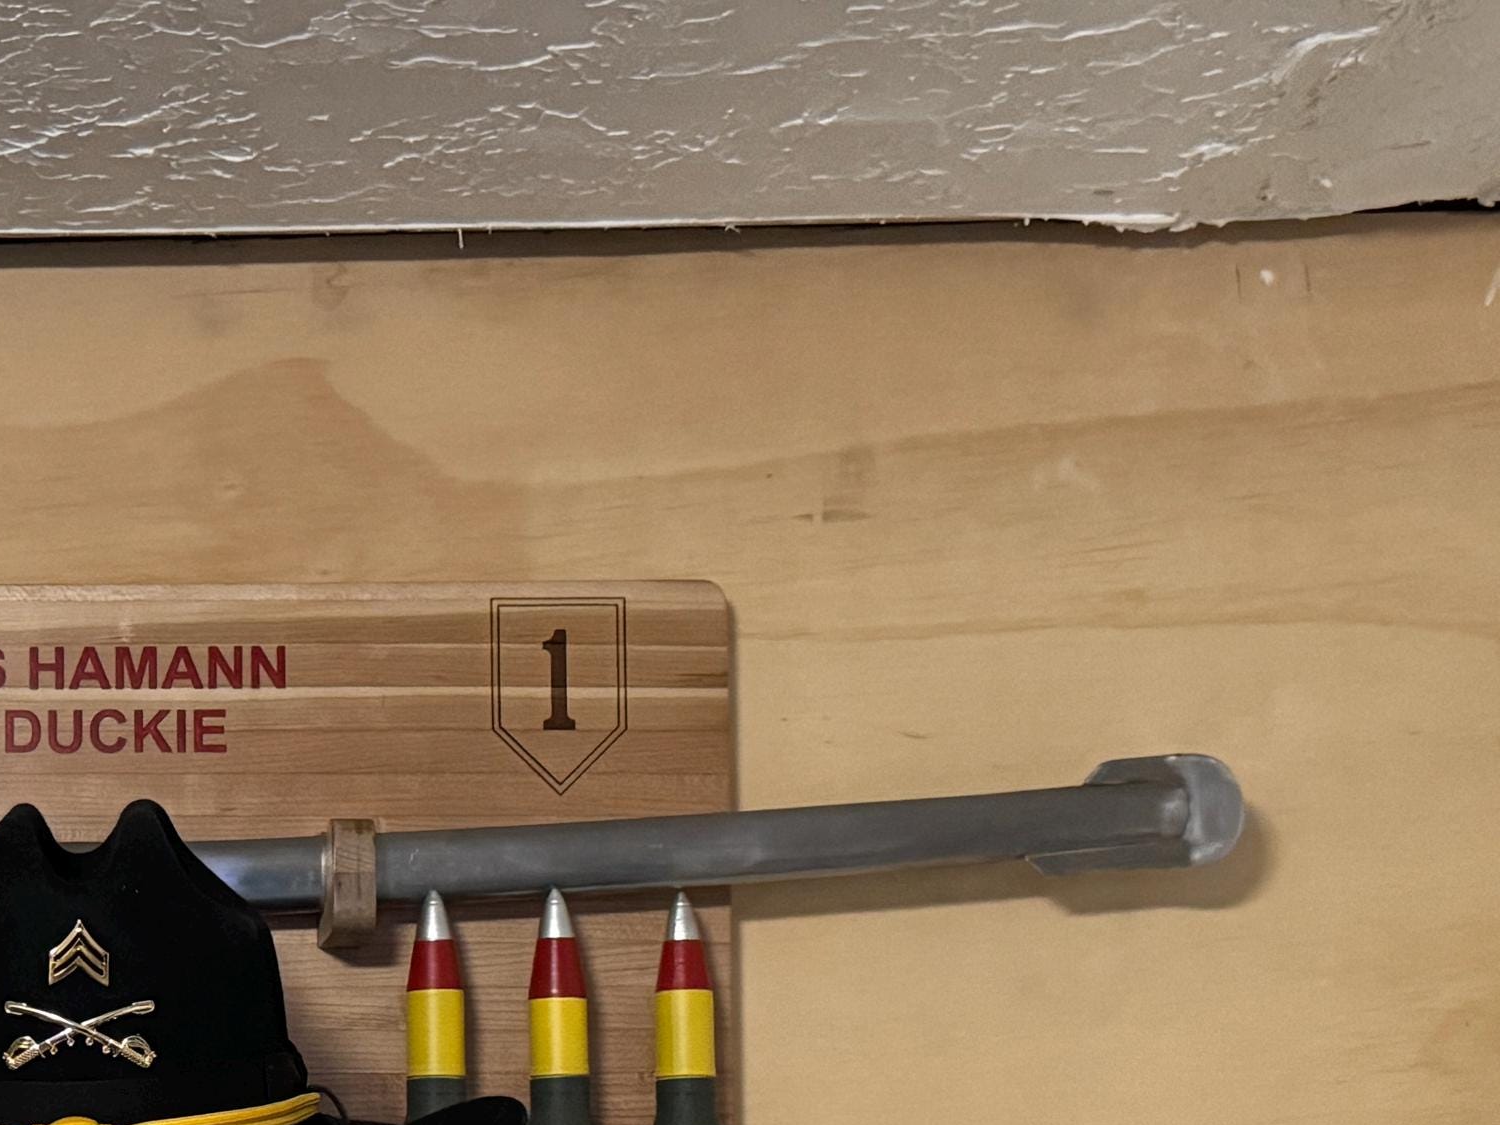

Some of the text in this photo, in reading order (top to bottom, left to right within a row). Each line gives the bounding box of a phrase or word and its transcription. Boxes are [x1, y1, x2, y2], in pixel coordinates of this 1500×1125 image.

[28, 645, 287, 691] HAMANN
[542, 629, 576, 731] 1
[4, 709, 228, 754] DUCKIE
